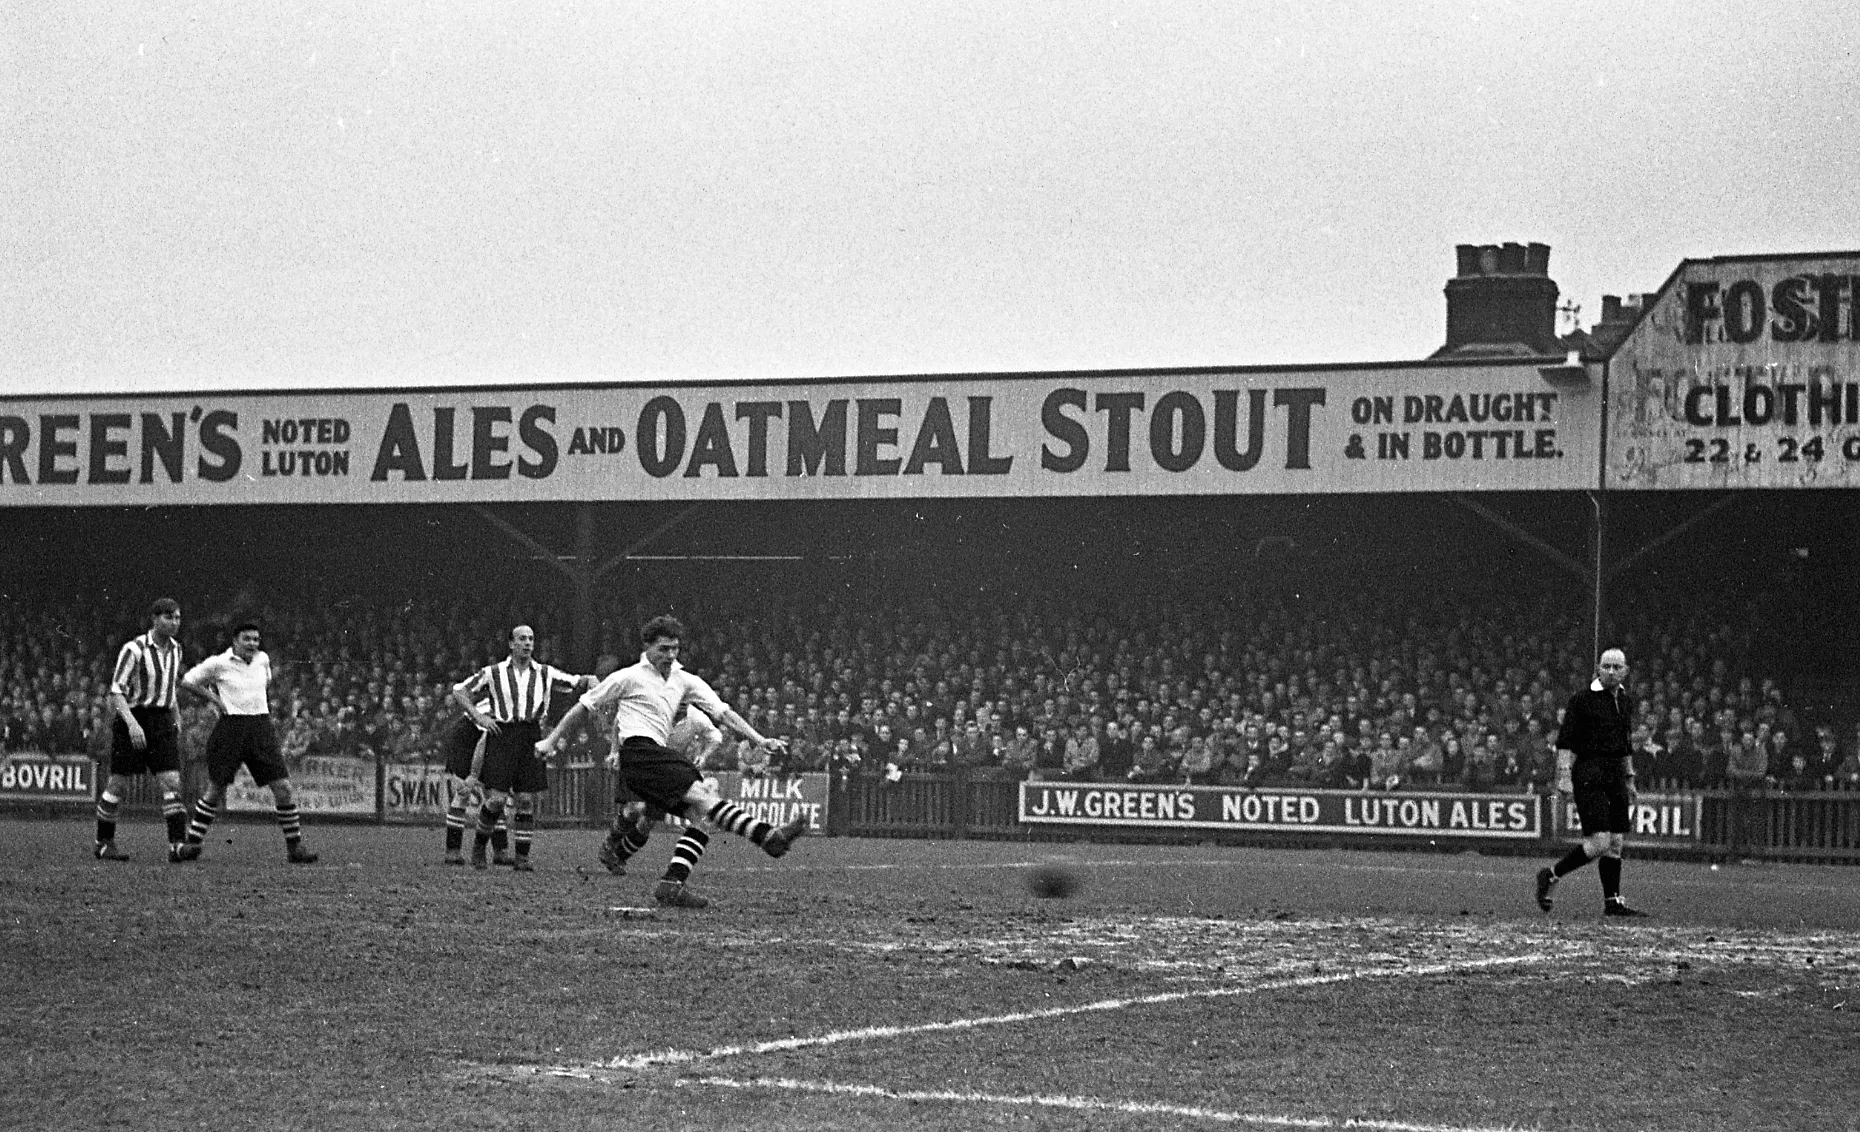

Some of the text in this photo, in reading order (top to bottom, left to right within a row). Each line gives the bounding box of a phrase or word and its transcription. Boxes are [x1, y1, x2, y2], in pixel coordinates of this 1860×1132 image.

[1683, 272, 1860, 344] FOST
[1351, 392, 1558, 425] ON DRAUGHT
[262, 418, 350, 445] NOTED
[370, 387, 1326, 482] ALES AND OATMEAL STOUT
[1344, 429, 1564, 460] & IN BOTTLE.
[262, 450, 349, 477] LUTON
[1684, 438, 1729, 462] 22
[1745, 443, 1761, 463] &
[1778, 436, 1824, 462] 24
[2, 763, 87, 790] BOVRIL
[388, 776, 441, 808] SWAN
[740, 778, 803, 799] MILK
[1222, 795, 1319, 824] NOTED
[1345, 798, 1439, 828] LUTON
[1450, 801, 1527, 830] ALES
[1566, 802, 1690, 835] BRIL
